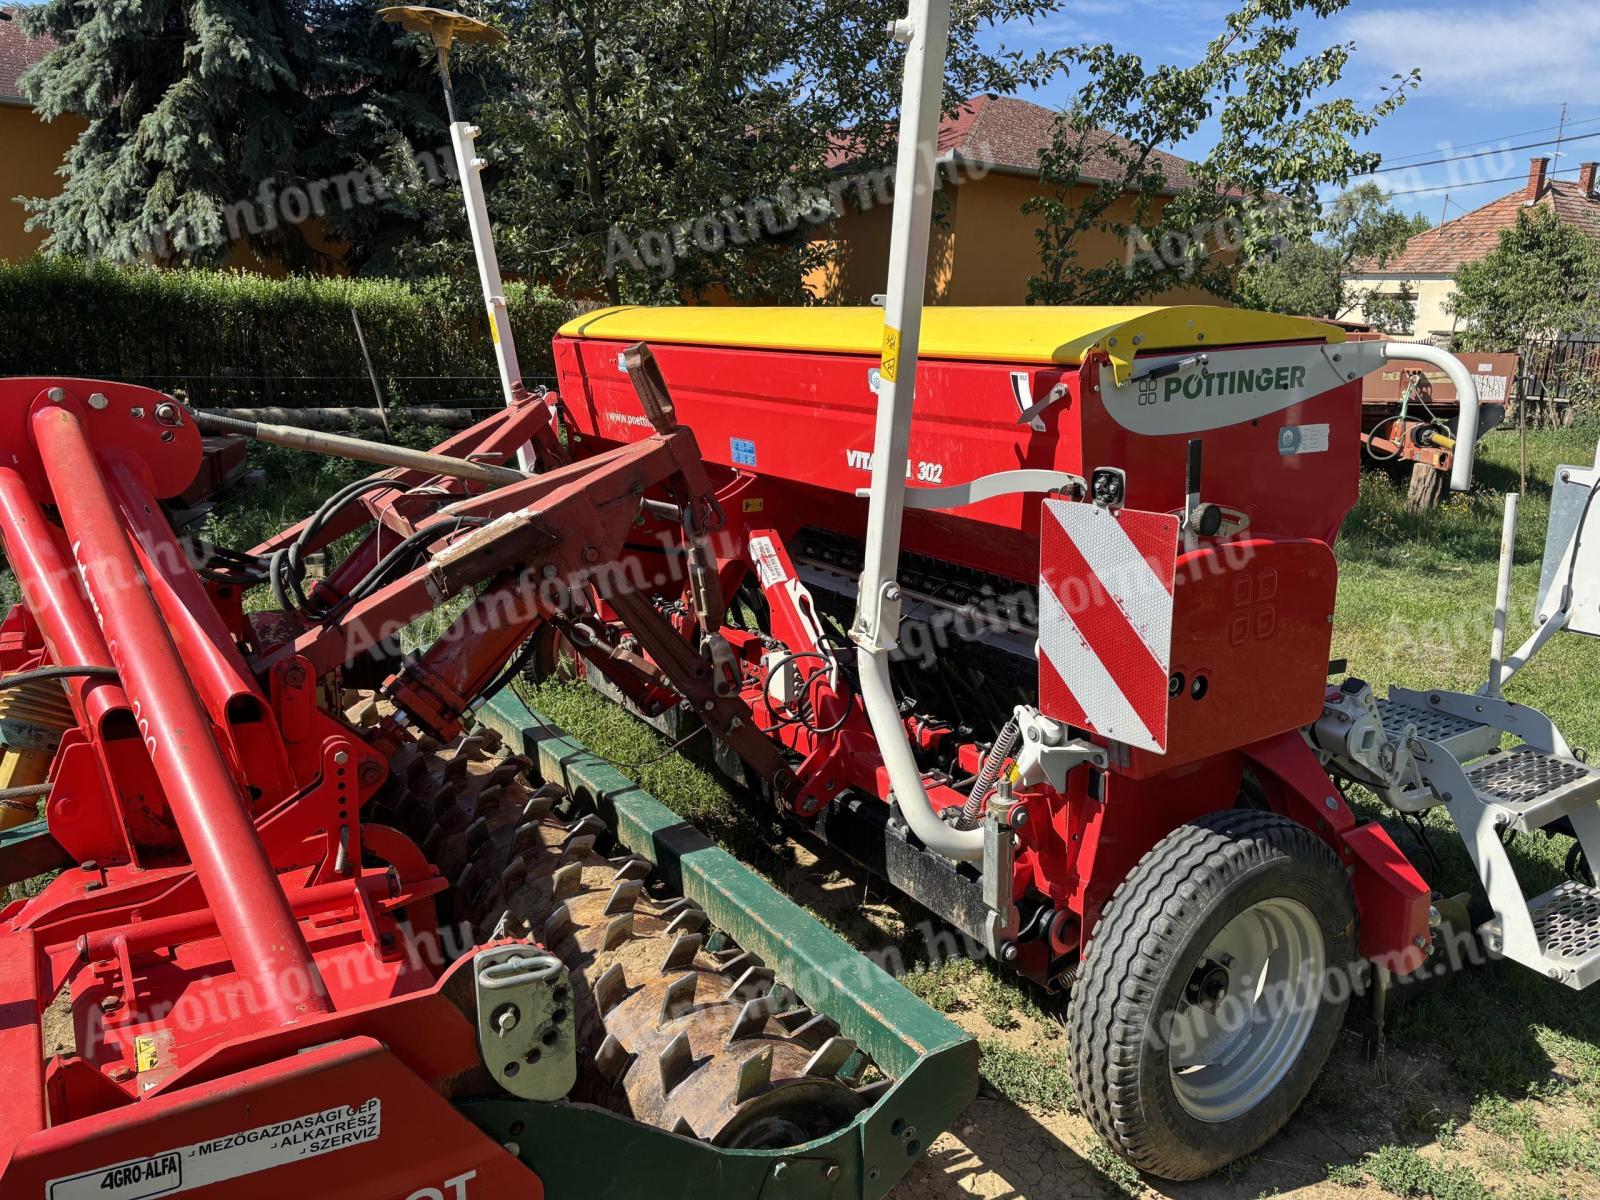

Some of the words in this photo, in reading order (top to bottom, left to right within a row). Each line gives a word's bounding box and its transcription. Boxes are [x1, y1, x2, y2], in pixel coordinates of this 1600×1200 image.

[917, 461, 943, 485] 302
[281, 1113, 376, 1147] ALKATRÉSZ
[310, 1126, 376, 1152] SZERVIZ
